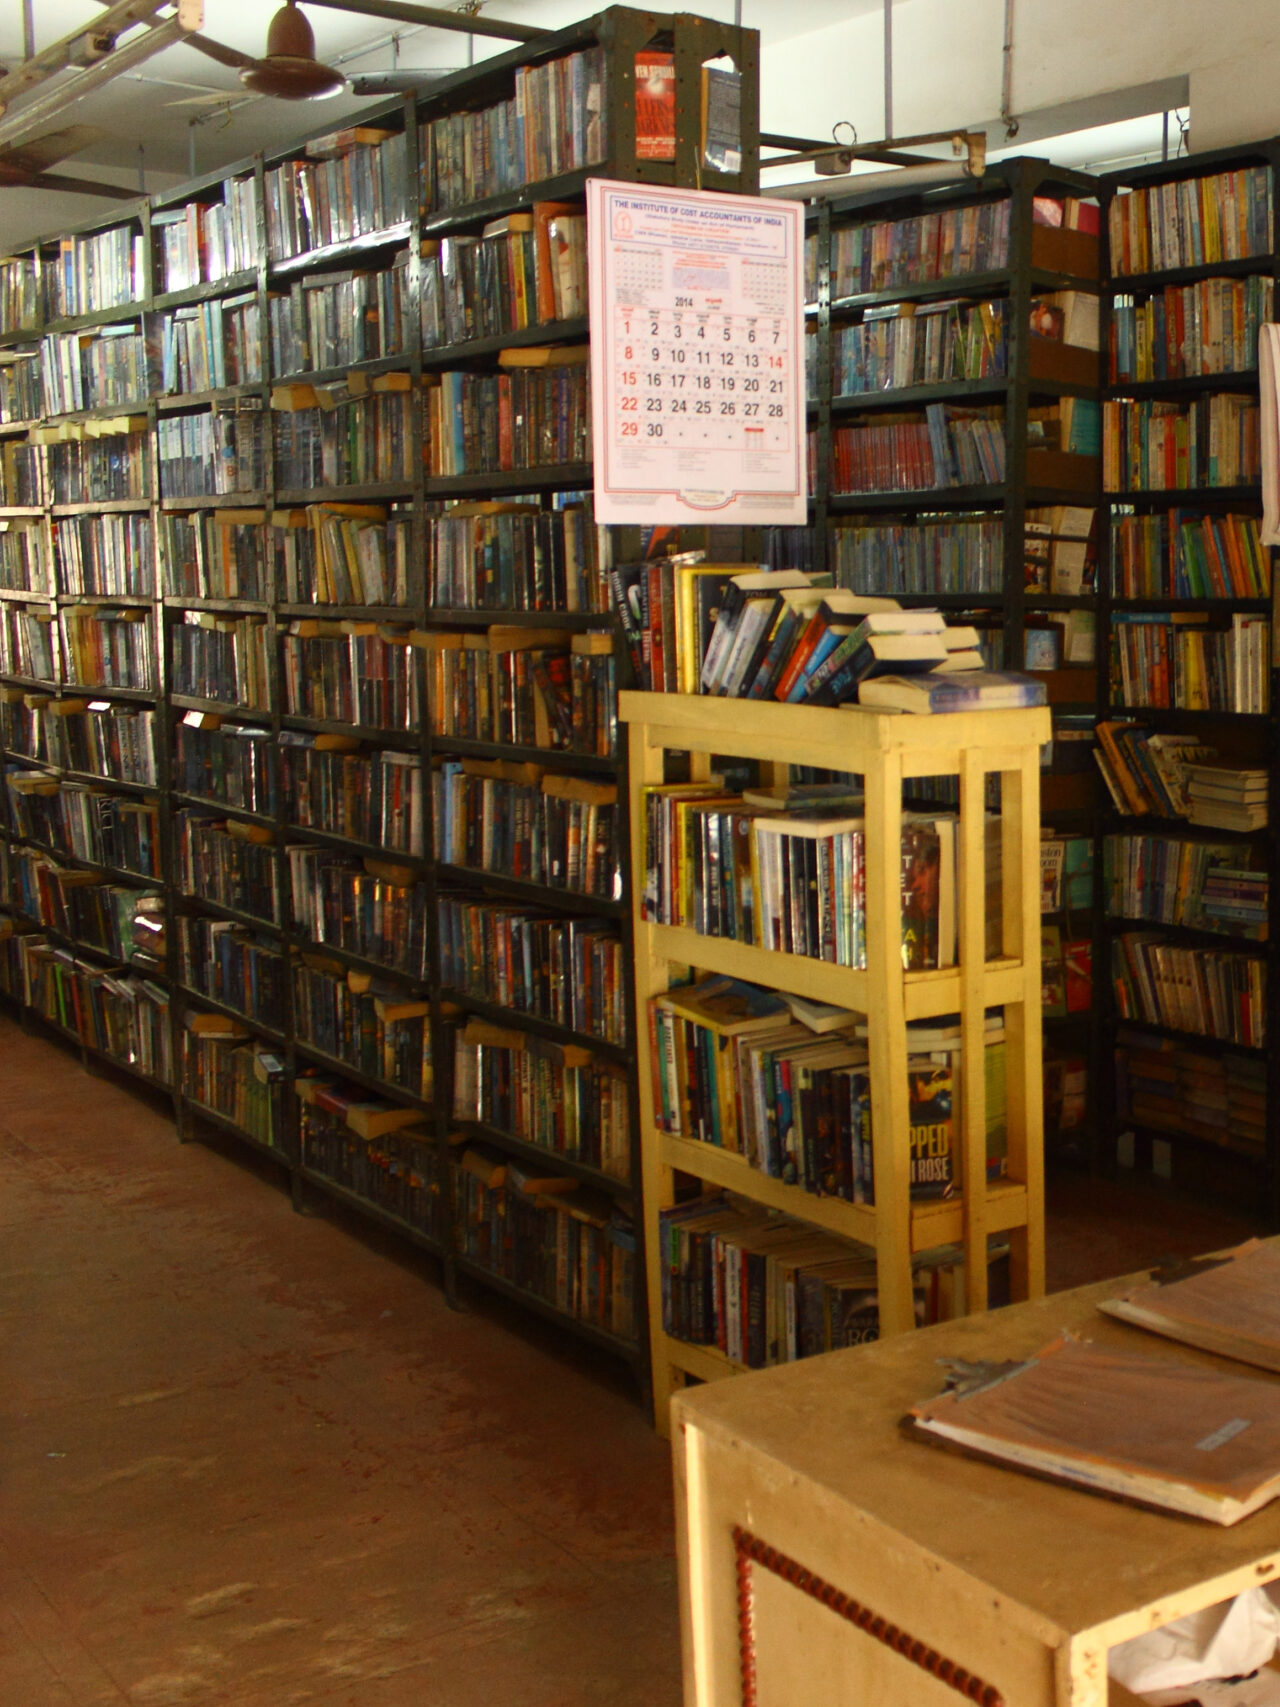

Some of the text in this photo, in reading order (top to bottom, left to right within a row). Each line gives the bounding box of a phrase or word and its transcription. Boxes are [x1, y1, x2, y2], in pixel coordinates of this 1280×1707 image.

[615, 200, 782, 227] THE INSTITUTE OF COST ACCOUNTANTS OF INDIA
[675, 296, 693, 307] 2014
[624, 321, 781, 344] 1 2 3 4 5 6 7
[625, 346, 782, 368] 8 9 10 11 12 13 14
[622, 372, 782, 393] 15 16 17 18 19 20 21
[622, 397, 783, 417] 22 23 24 25 26 27 28
[622, 422, 663, 437] 29 30
[611, 571, 631, 630] ROBIN COOK
[918, 1157, 949, 1182] ROSE
